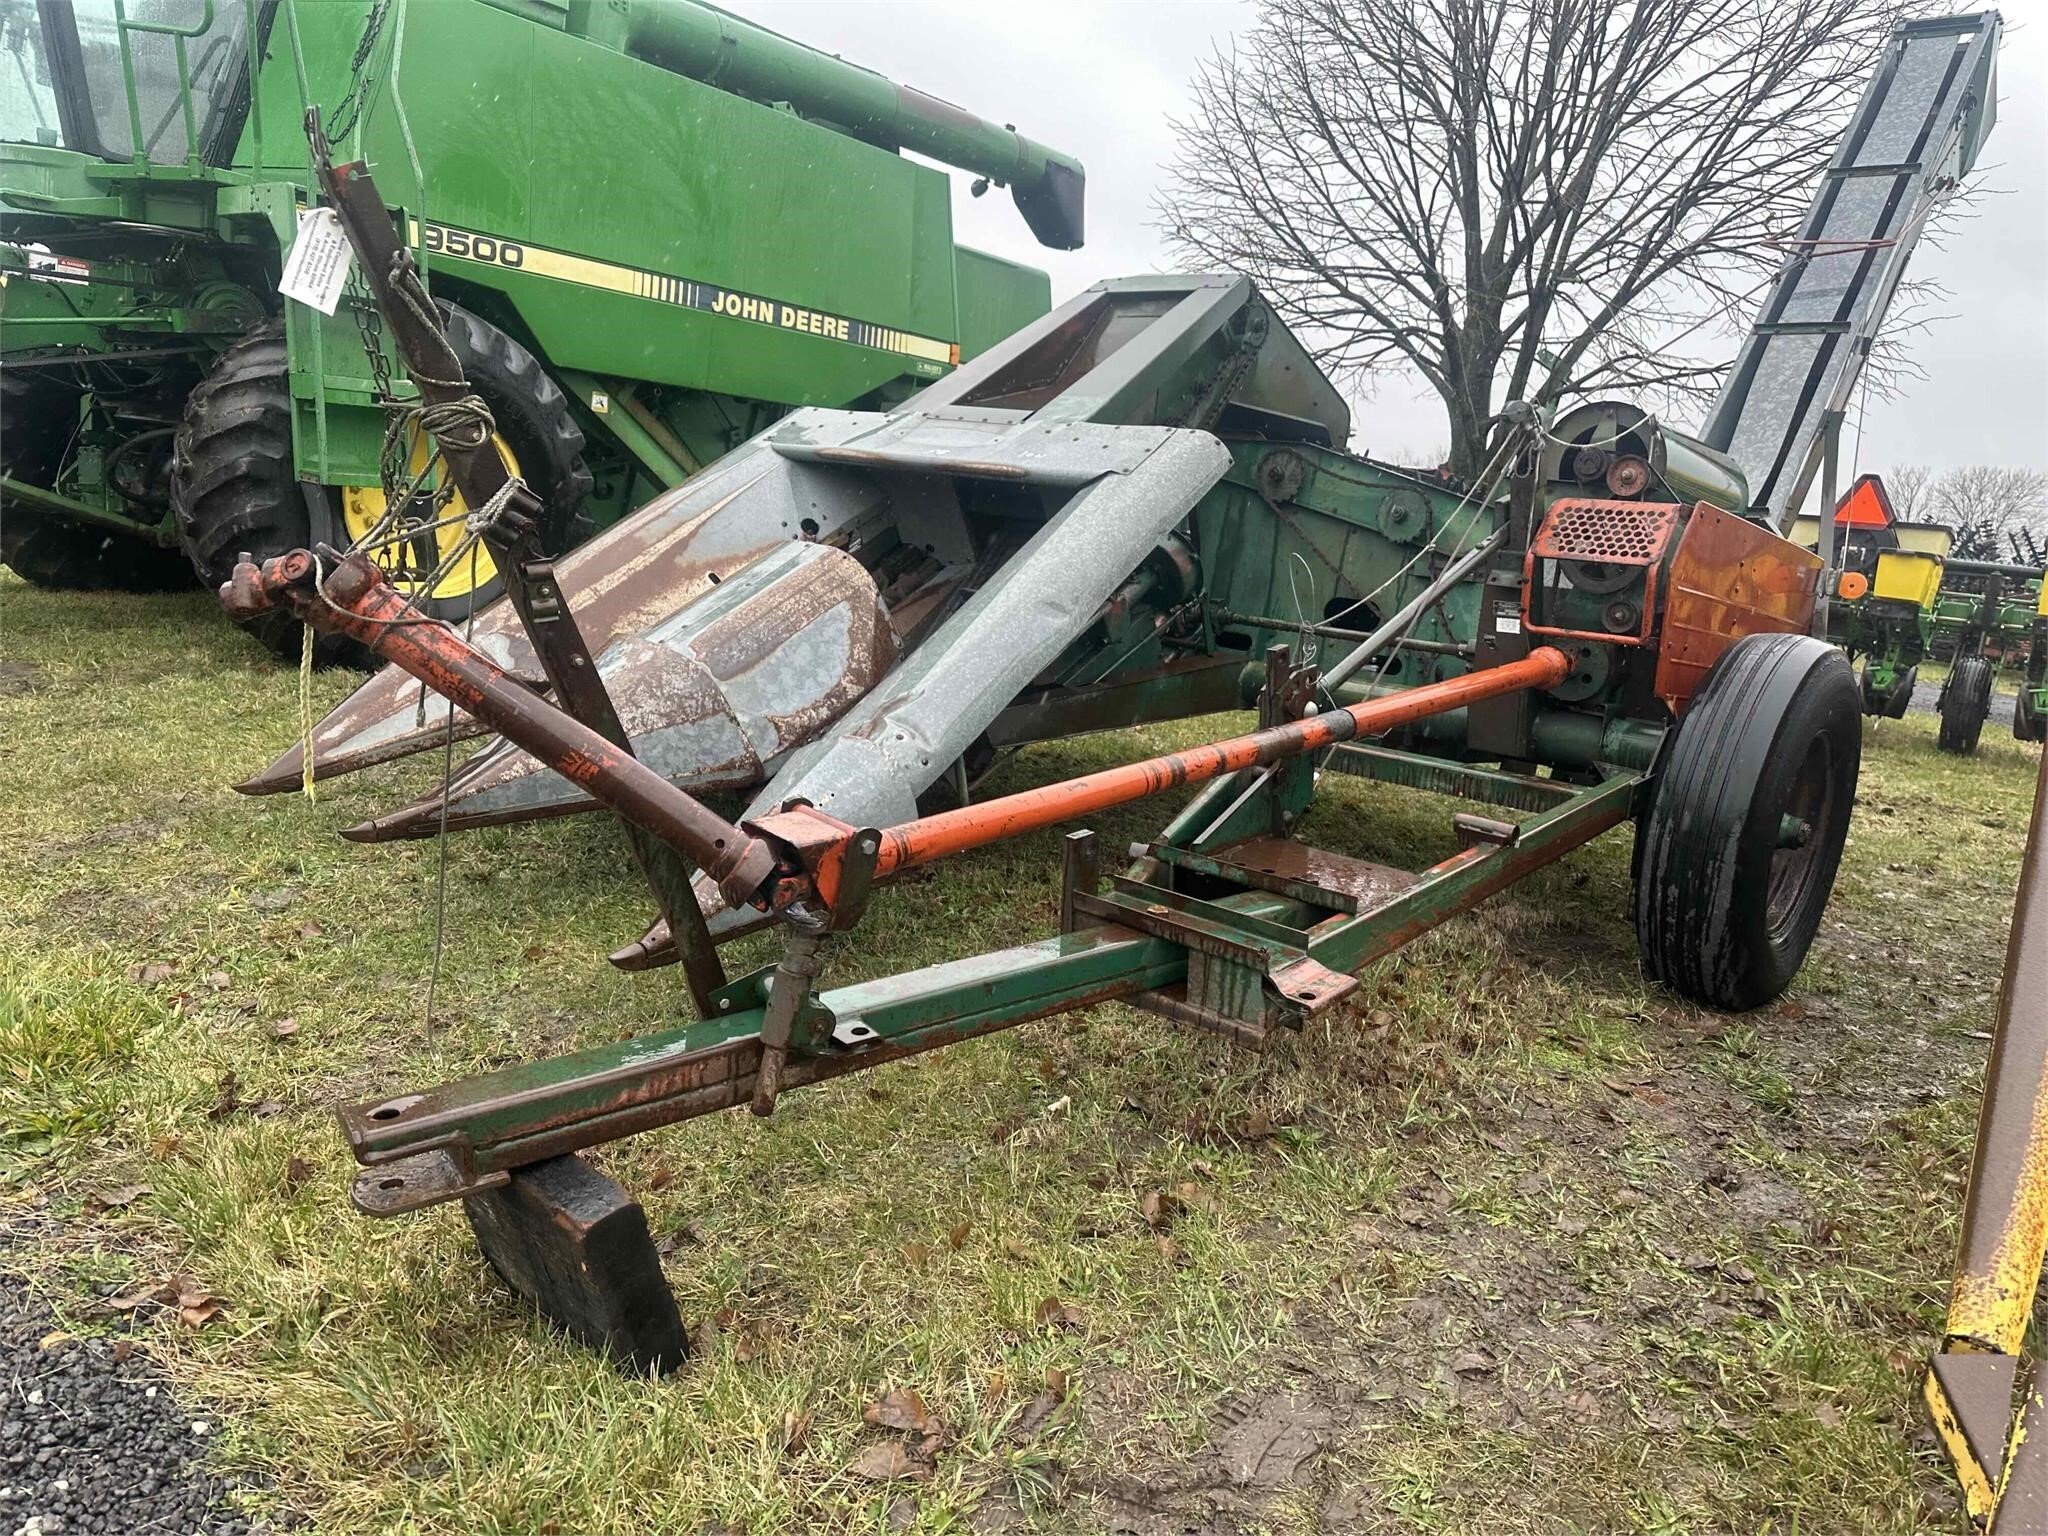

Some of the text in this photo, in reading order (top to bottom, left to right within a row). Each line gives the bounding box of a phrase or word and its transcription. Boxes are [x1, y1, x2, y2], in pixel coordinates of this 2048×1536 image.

[426, 226, 523, 267] 9500
[712, 291, 850, 340] JOHN DEERE
